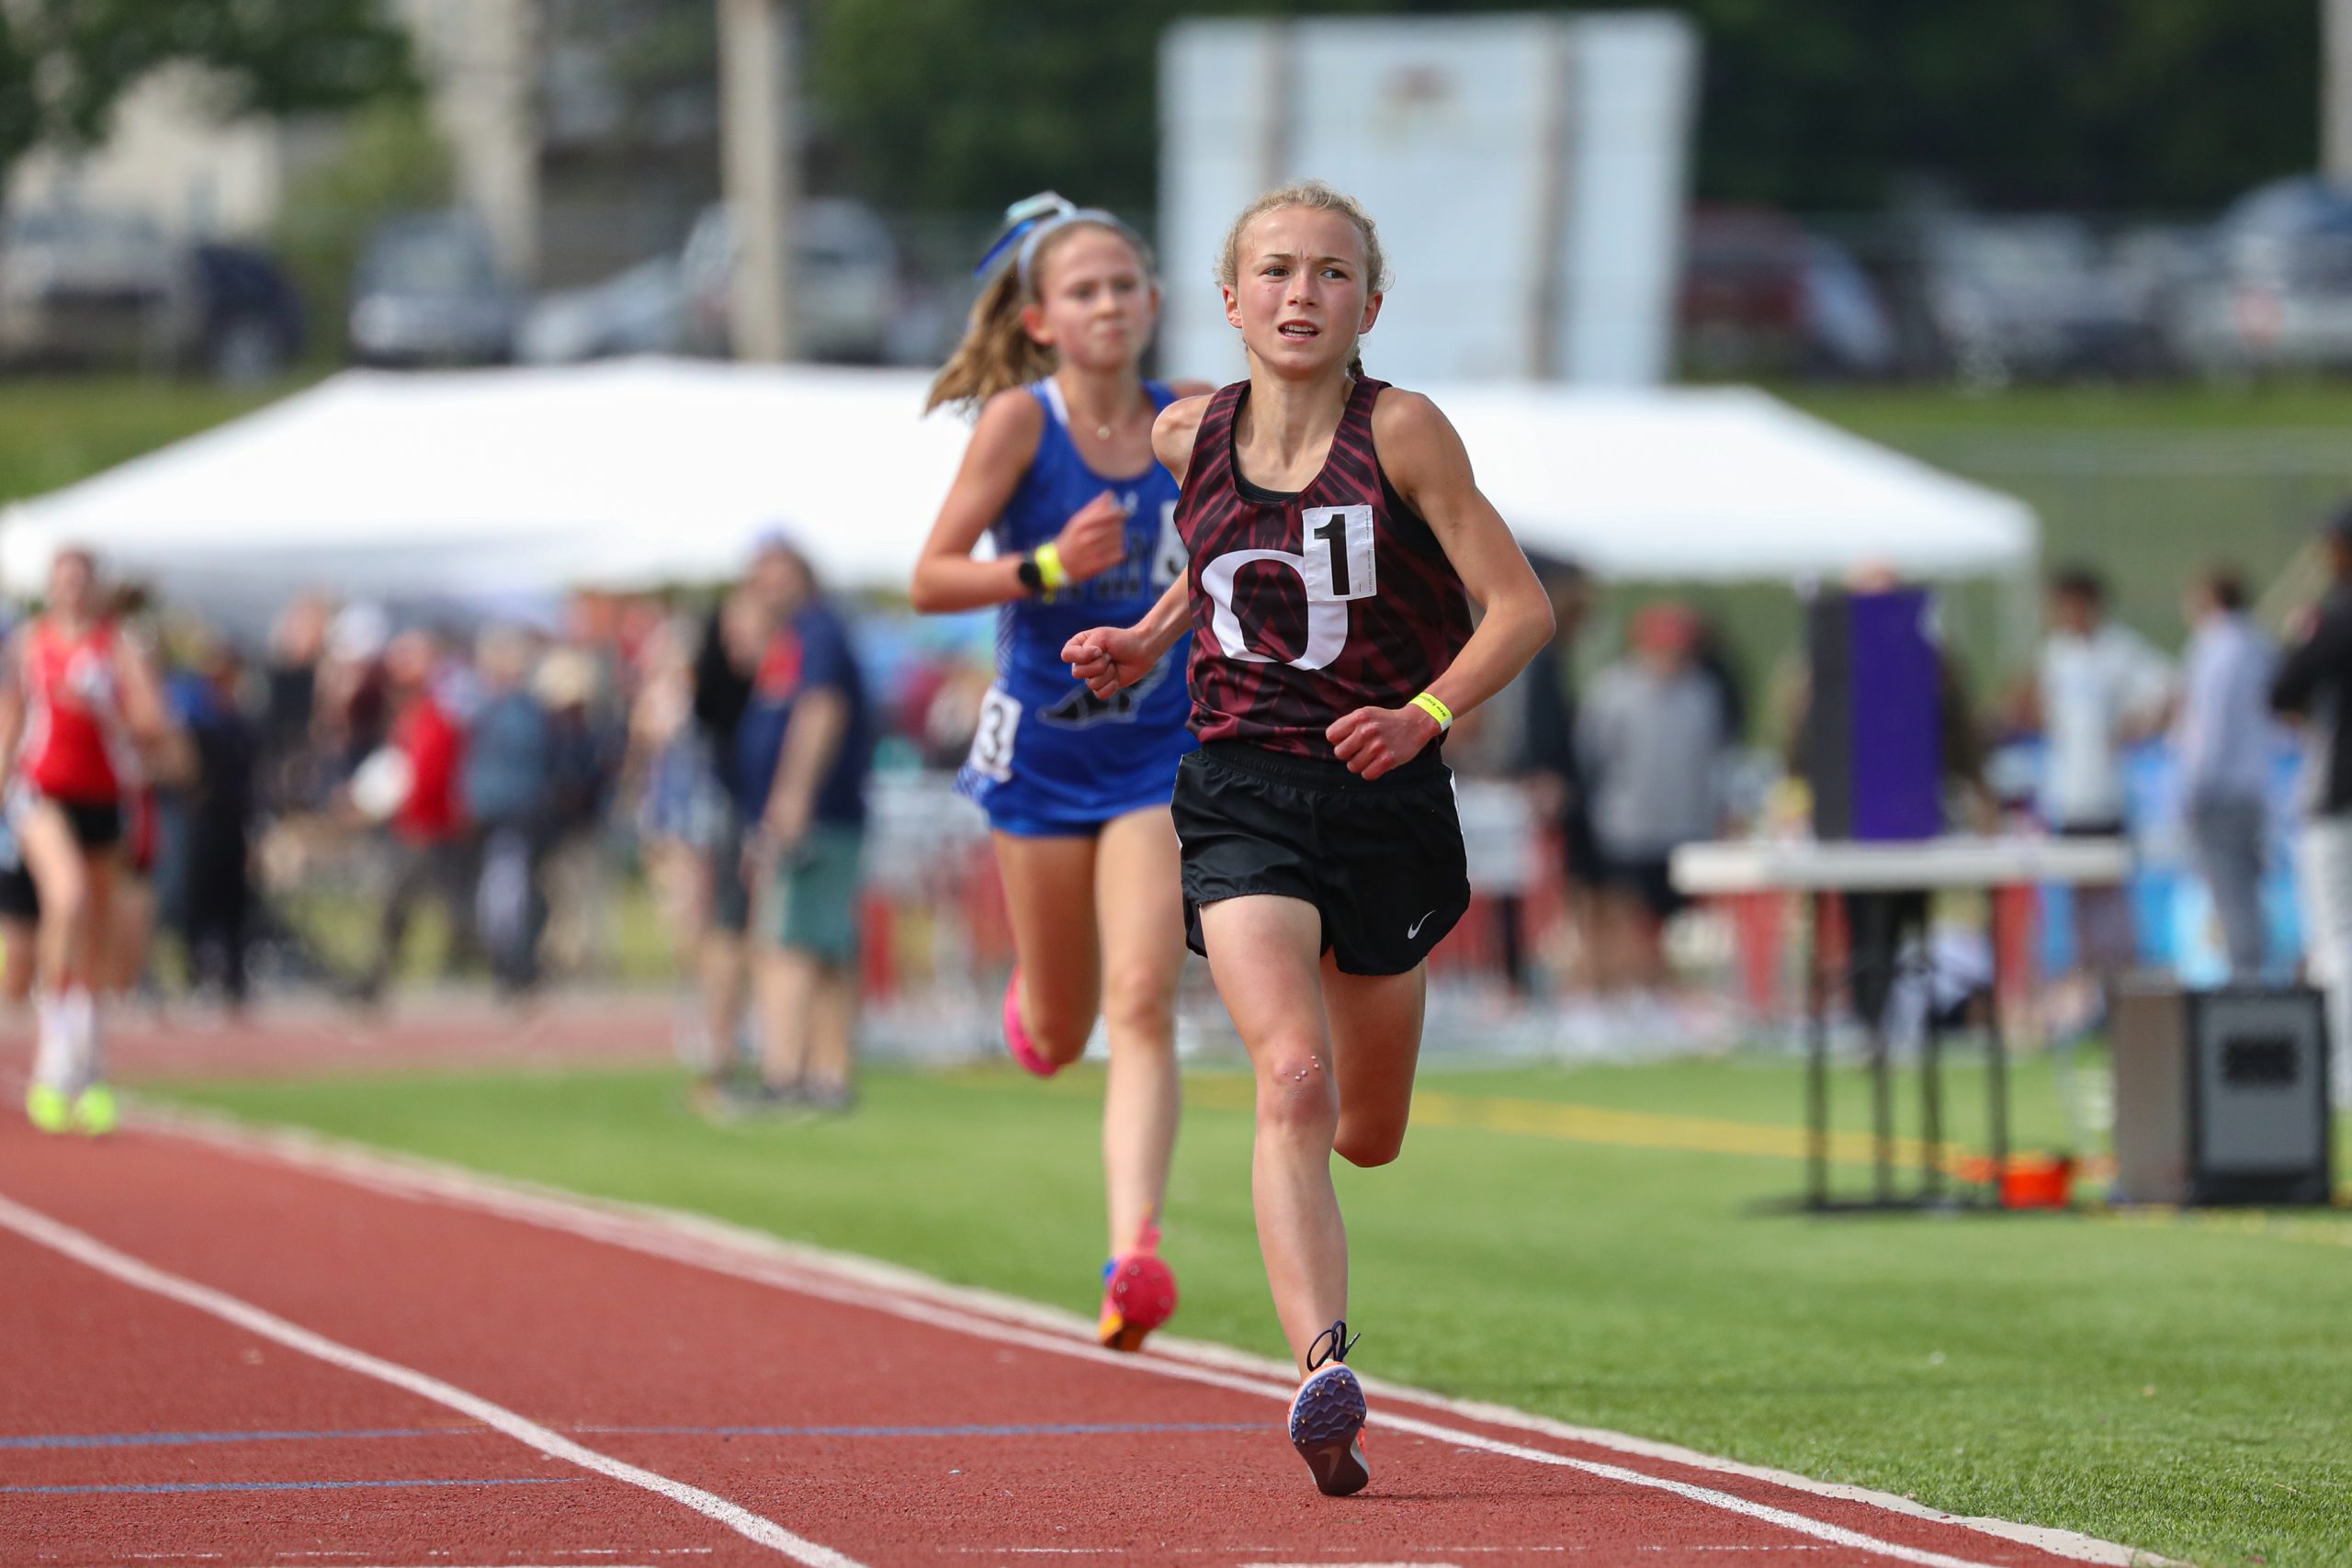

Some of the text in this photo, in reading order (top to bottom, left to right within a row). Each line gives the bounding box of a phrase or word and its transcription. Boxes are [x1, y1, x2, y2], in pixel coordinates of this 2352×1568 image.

[1314, 513, 1351, 595] 1
[1201, 548, 1348, 671] O
[980, 704, 1003, 764] 3
